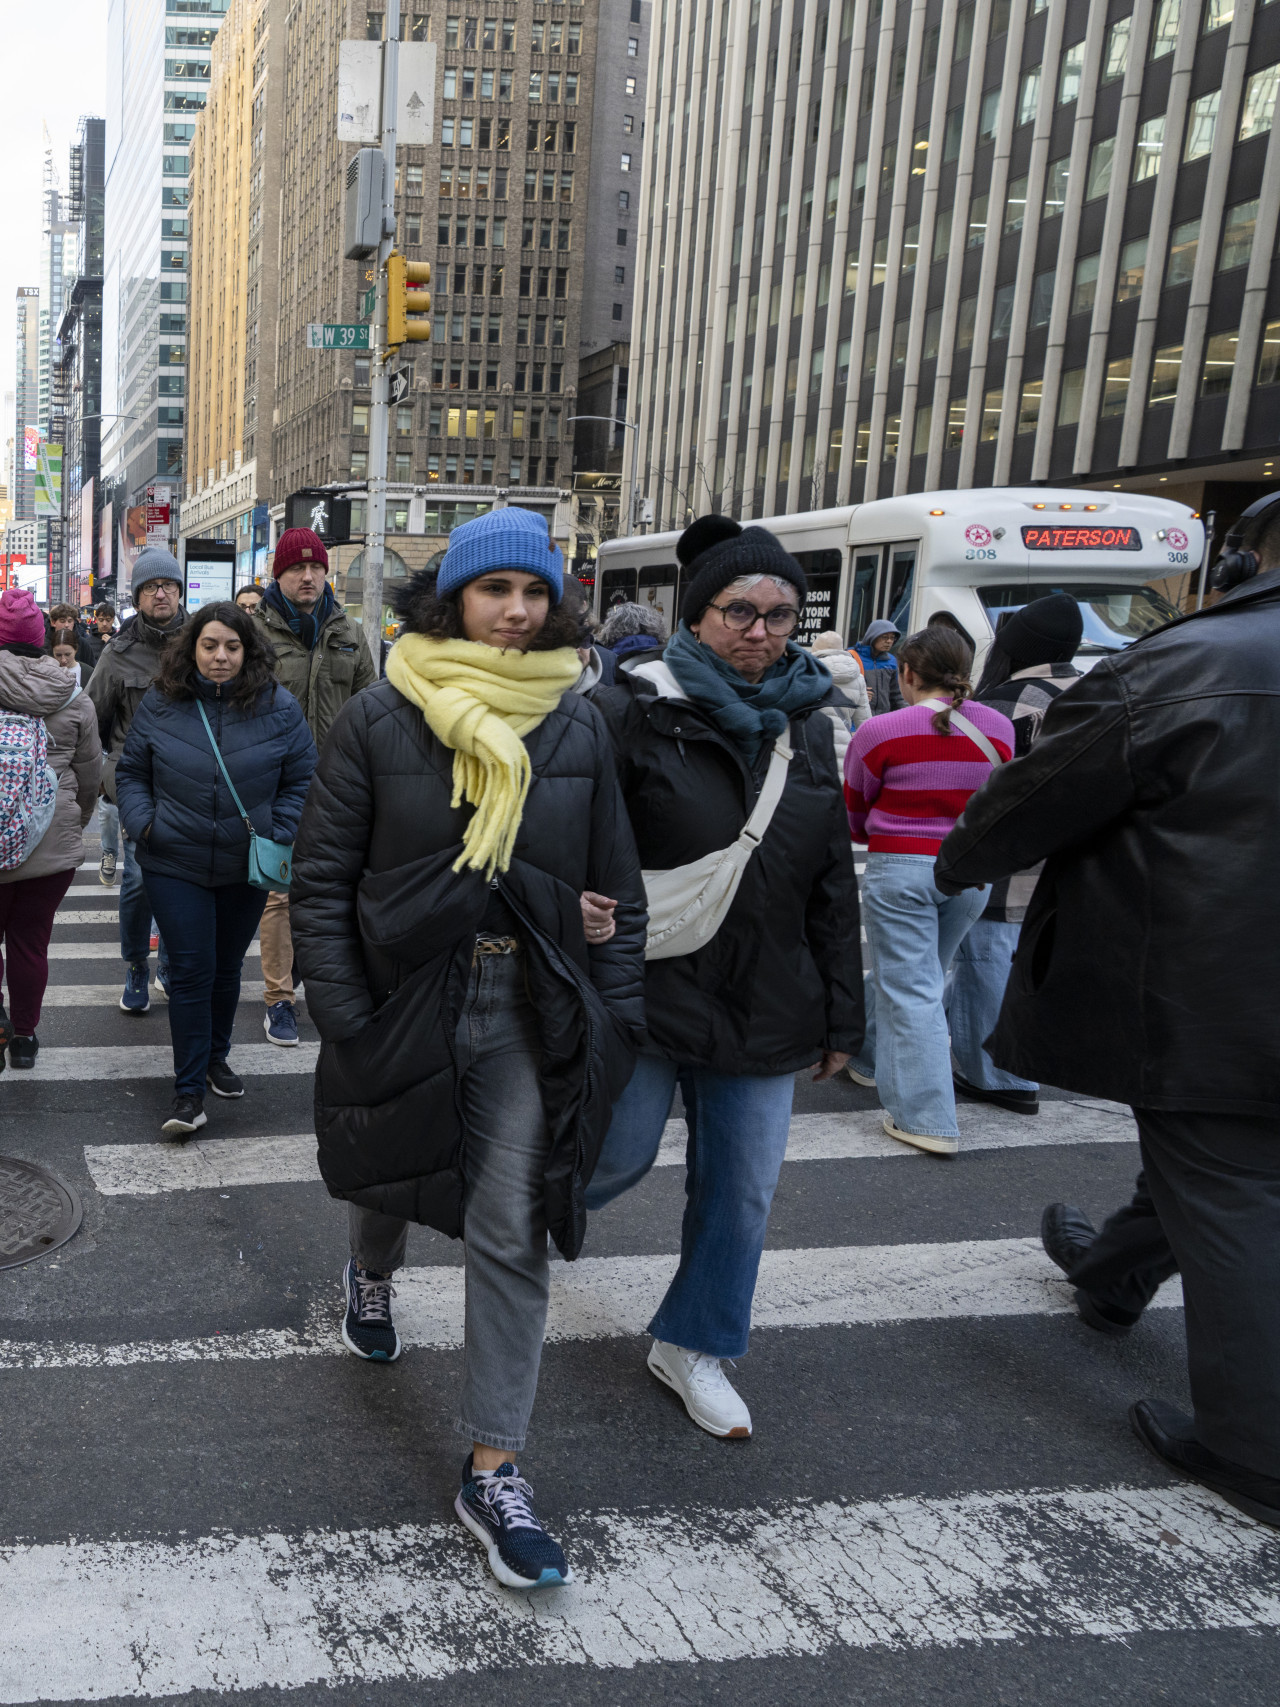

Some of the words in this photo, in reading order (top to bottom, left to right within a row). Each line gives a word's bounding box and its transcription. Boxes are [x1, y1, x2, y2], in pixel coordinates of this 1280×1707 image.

[23, 288, 39, 296] TSX
[324, 328, 335, 345] W
[340, 328, 355, 345] 39
[360, 328, 368, 339] St
[1025, 529, 1132, 546] PATERSON
[965, 548, 997, 560] 308
[1167, 551, 1189, 564] 308
[806, 591, 831, 602] RSON
[806, 606, 831, 618] YORK
[804, 618, 822, 629] AVE
